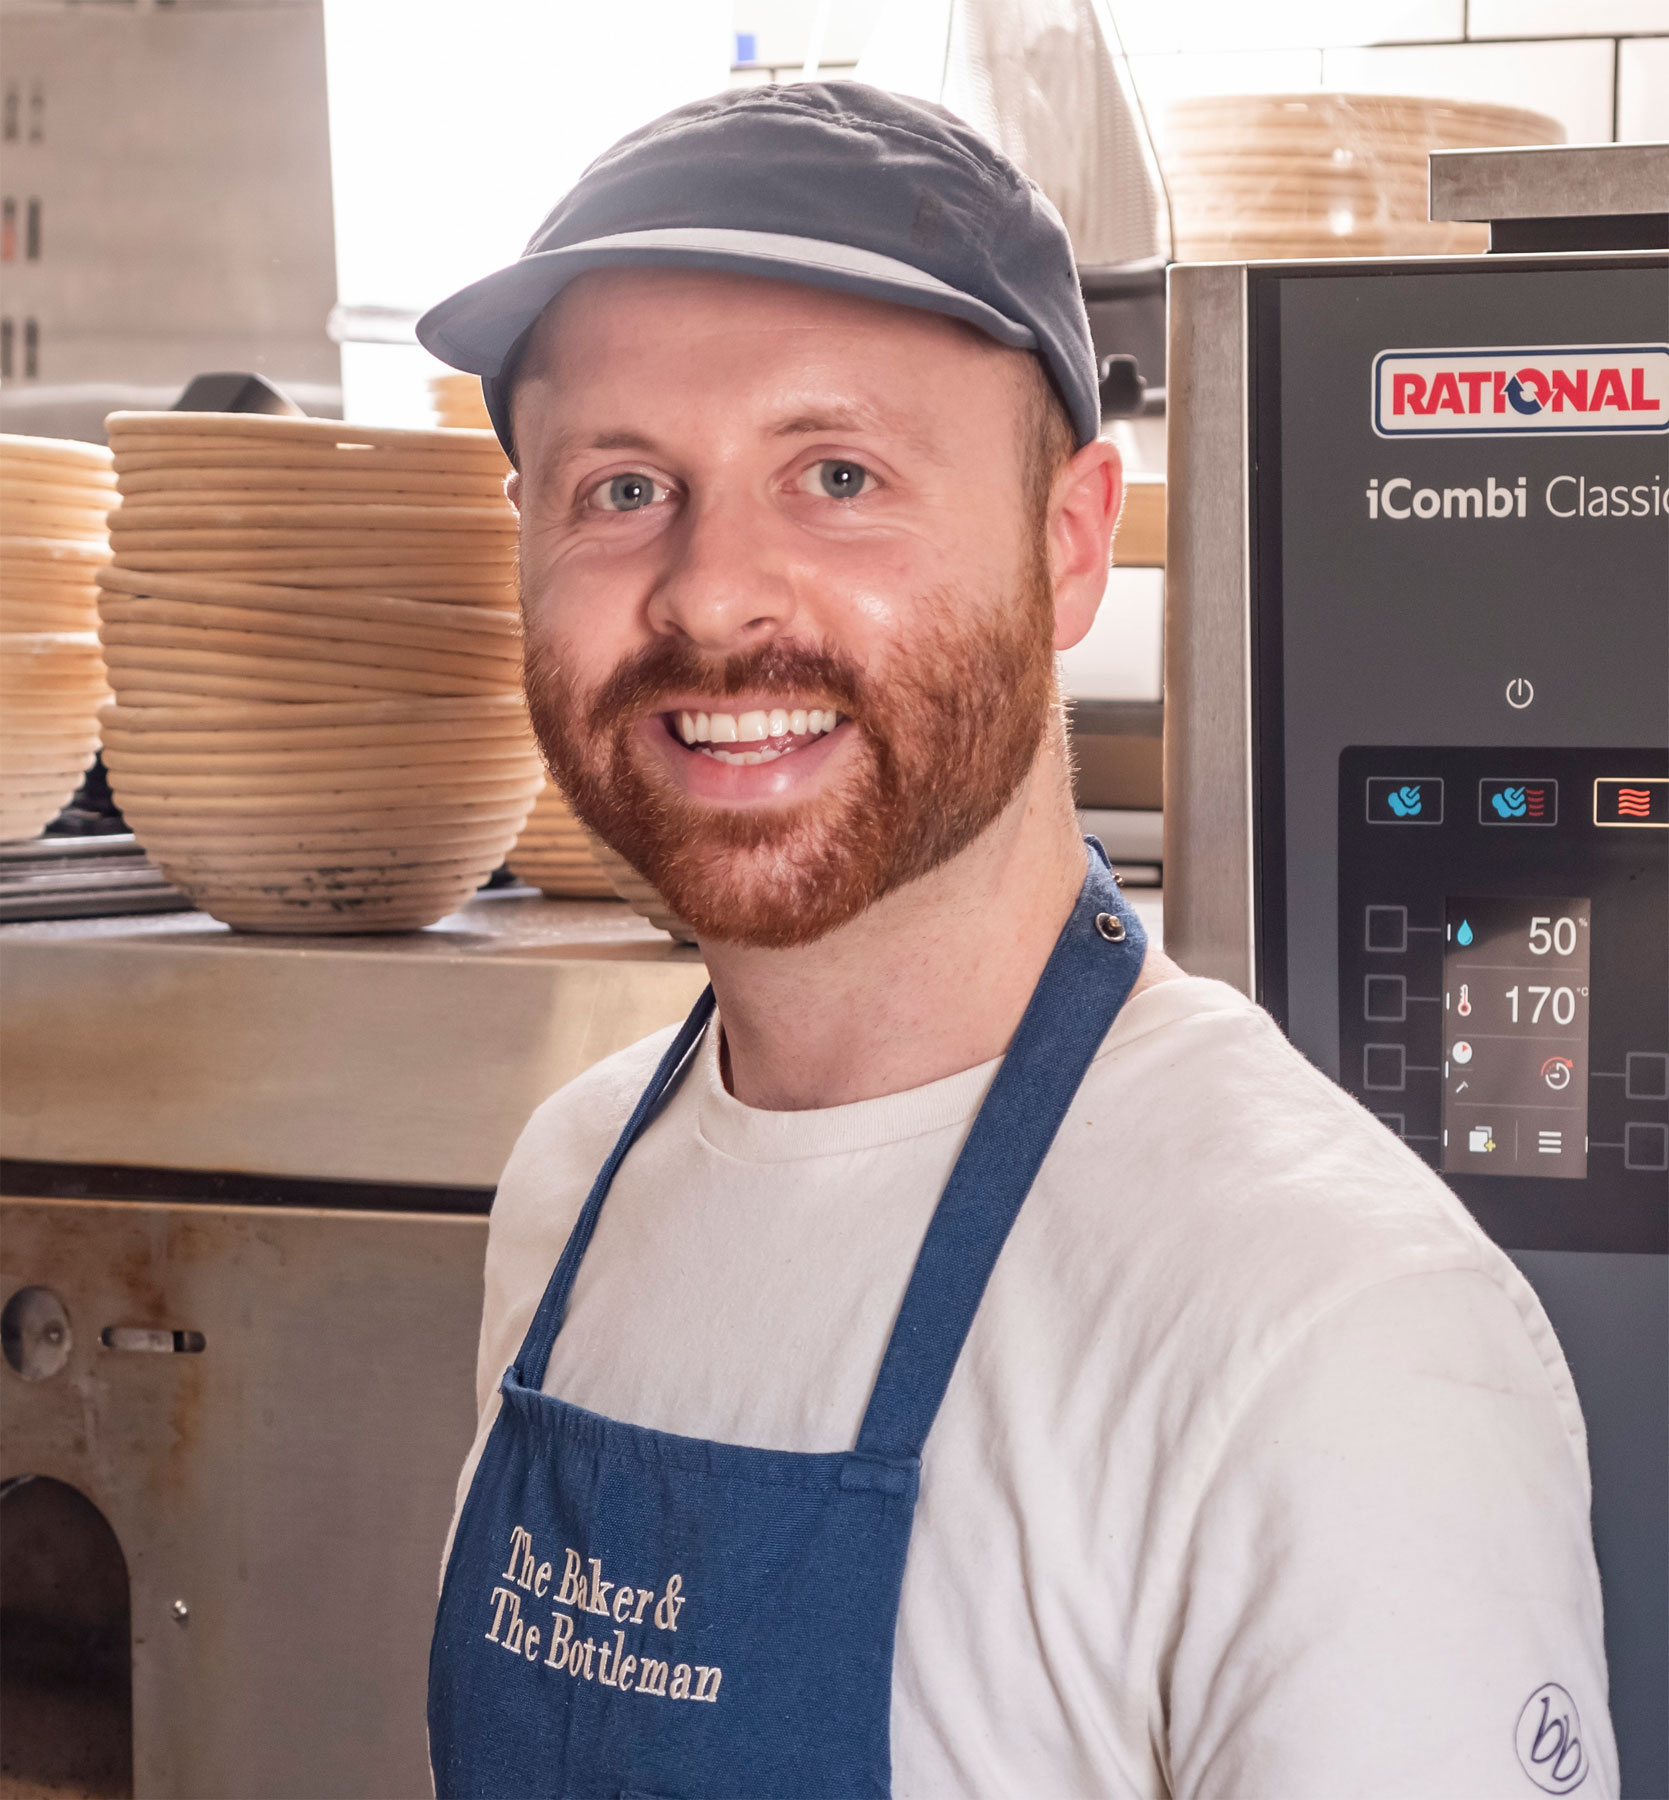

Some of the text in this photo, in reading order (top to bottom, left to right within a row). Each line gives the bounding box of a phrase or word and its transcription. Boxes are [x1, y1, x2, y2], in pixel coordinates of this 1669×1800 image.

[1392, 368, 1661, 415] RATIONAL
[1366, 476, 1527, 519] iCombi
[502, 1525, 686, 1632] The Baker &
[485, 1586, 723, 1703] The Bottleman
